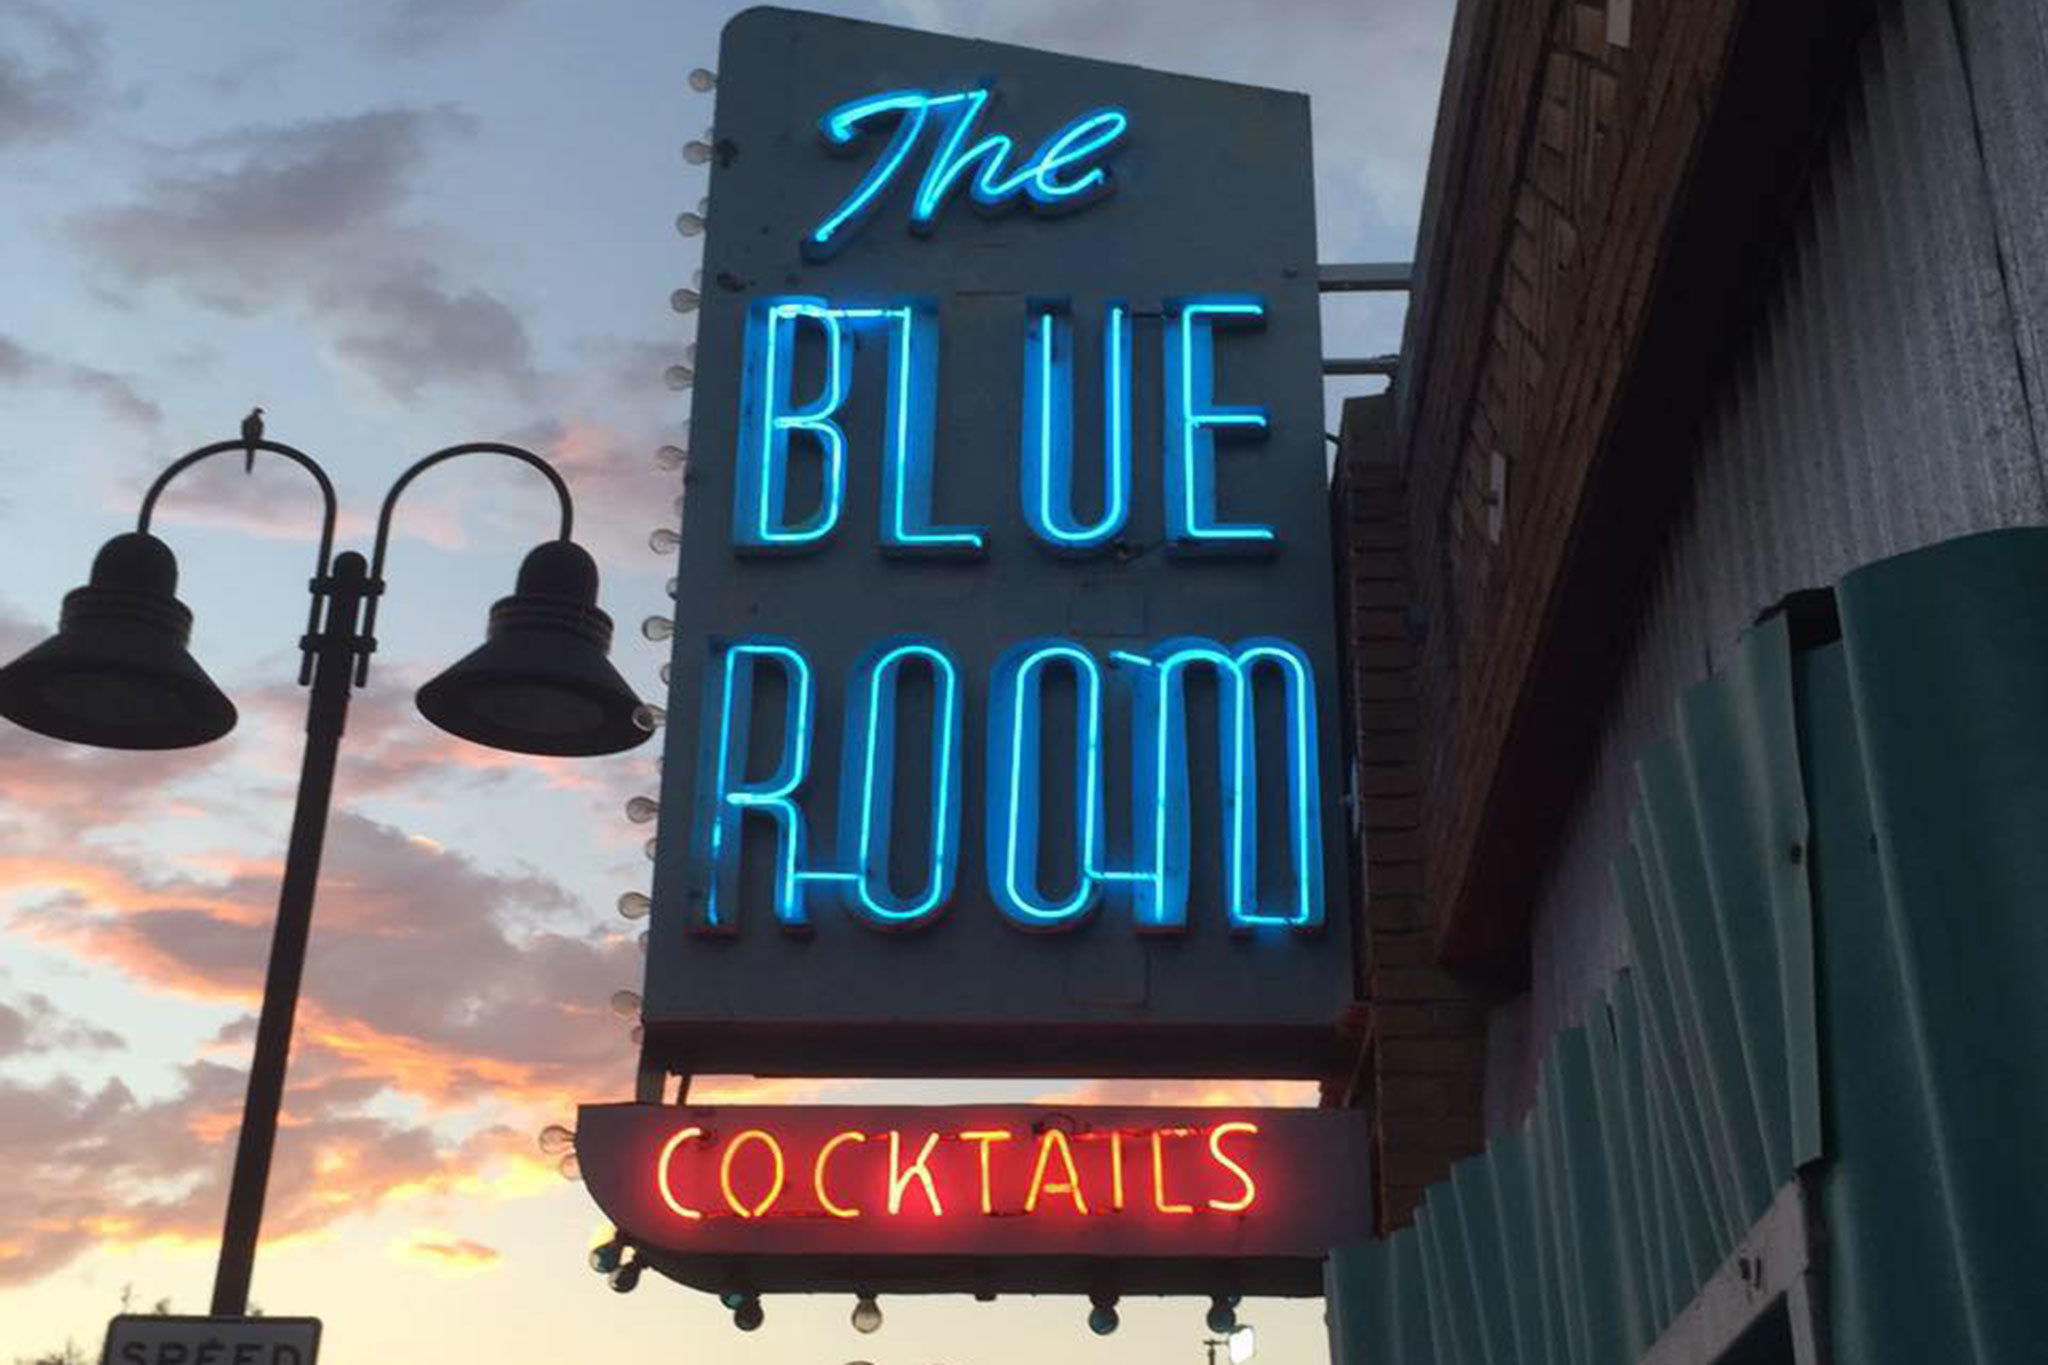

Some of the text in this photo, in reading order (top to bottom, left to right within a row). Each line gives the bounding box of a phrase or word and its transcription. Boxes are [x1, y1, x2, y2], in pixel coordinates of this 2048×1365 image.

[812, 86, 1130, 246] The
[735, 298, 1276, 552] BLUE
[696, 636, 1325, 930] ROOM
[656, 1121, 1259, 1219] COCKTAILS
